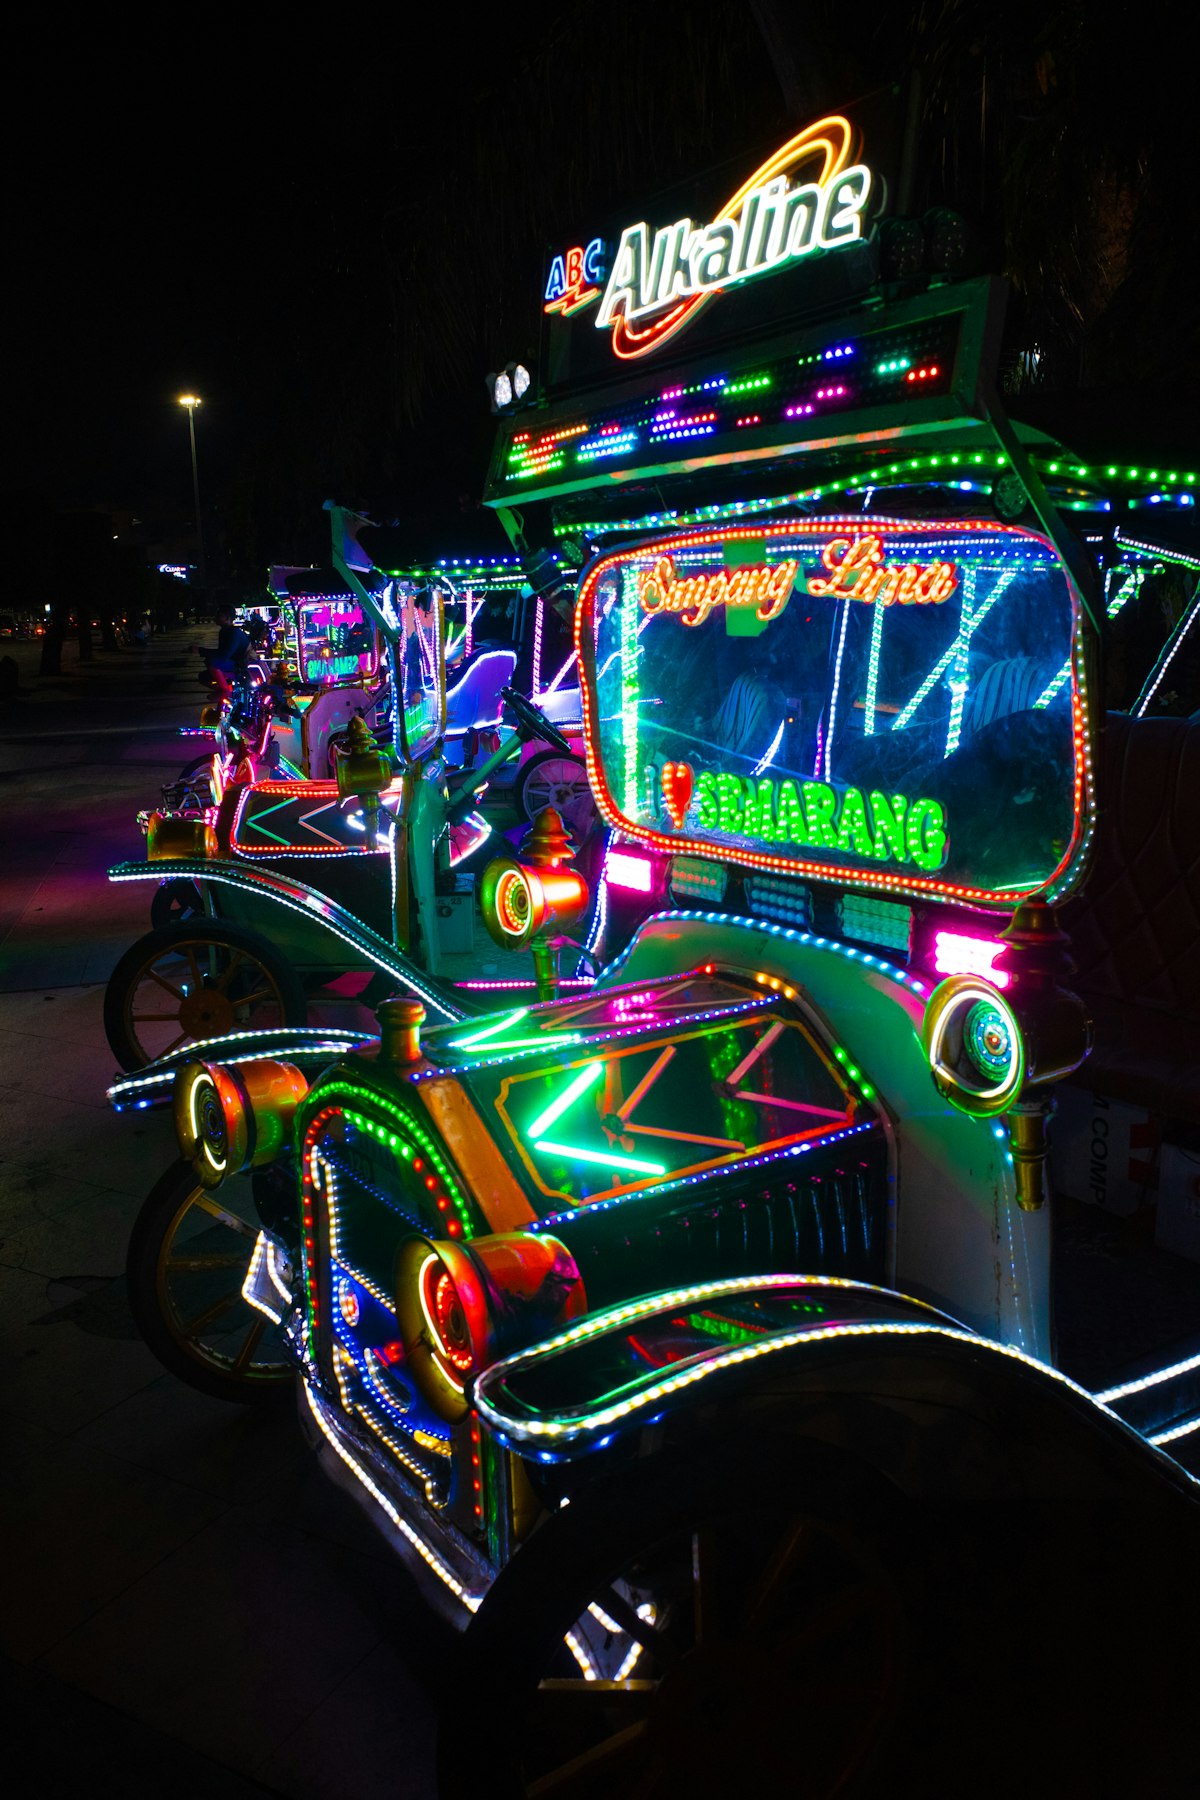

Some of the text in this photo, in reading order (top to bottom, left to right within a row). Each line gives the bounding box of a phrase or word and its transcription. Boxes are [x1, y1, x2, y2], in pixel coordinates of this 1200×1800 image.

[545, 164, 872, 328] ABC Alkaline
[807, 534, 958, 606] Lima
[696, 770, 947, 872] SEMARANG
[1089, 1116, 1109, 1206] COMP
